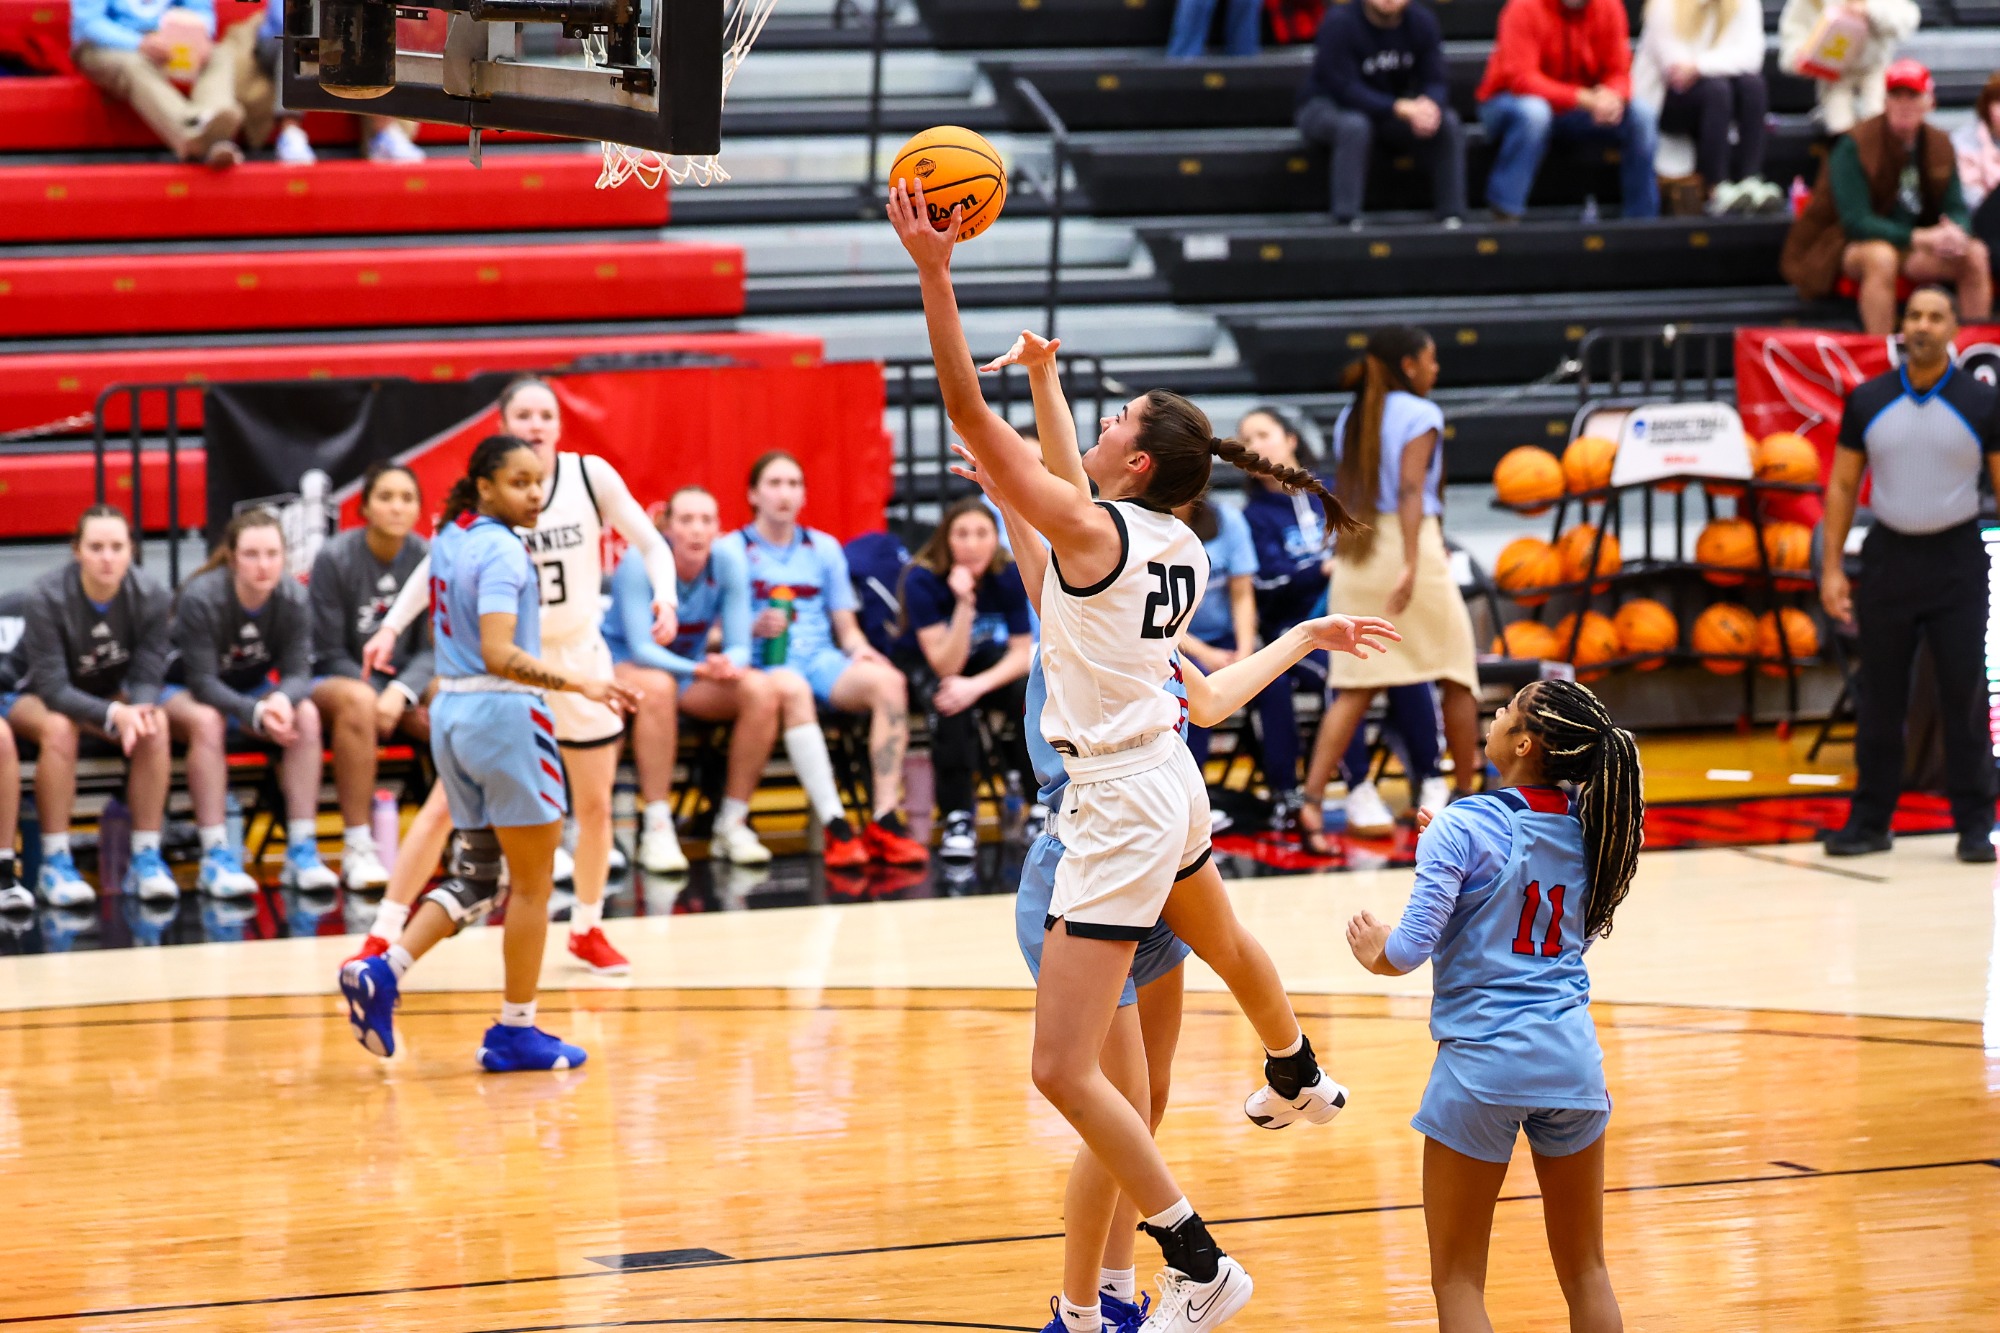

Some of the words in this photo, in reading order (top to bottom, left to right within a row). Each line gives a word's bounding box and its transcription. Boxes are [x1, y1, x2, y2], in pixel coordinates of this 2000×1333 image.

[926, 193, 979, 221] lson
[521, 523, 584, 553] NNIES
[1141, 561, 1196, 639] 20
[1511, 879, 1567, 958] 11
